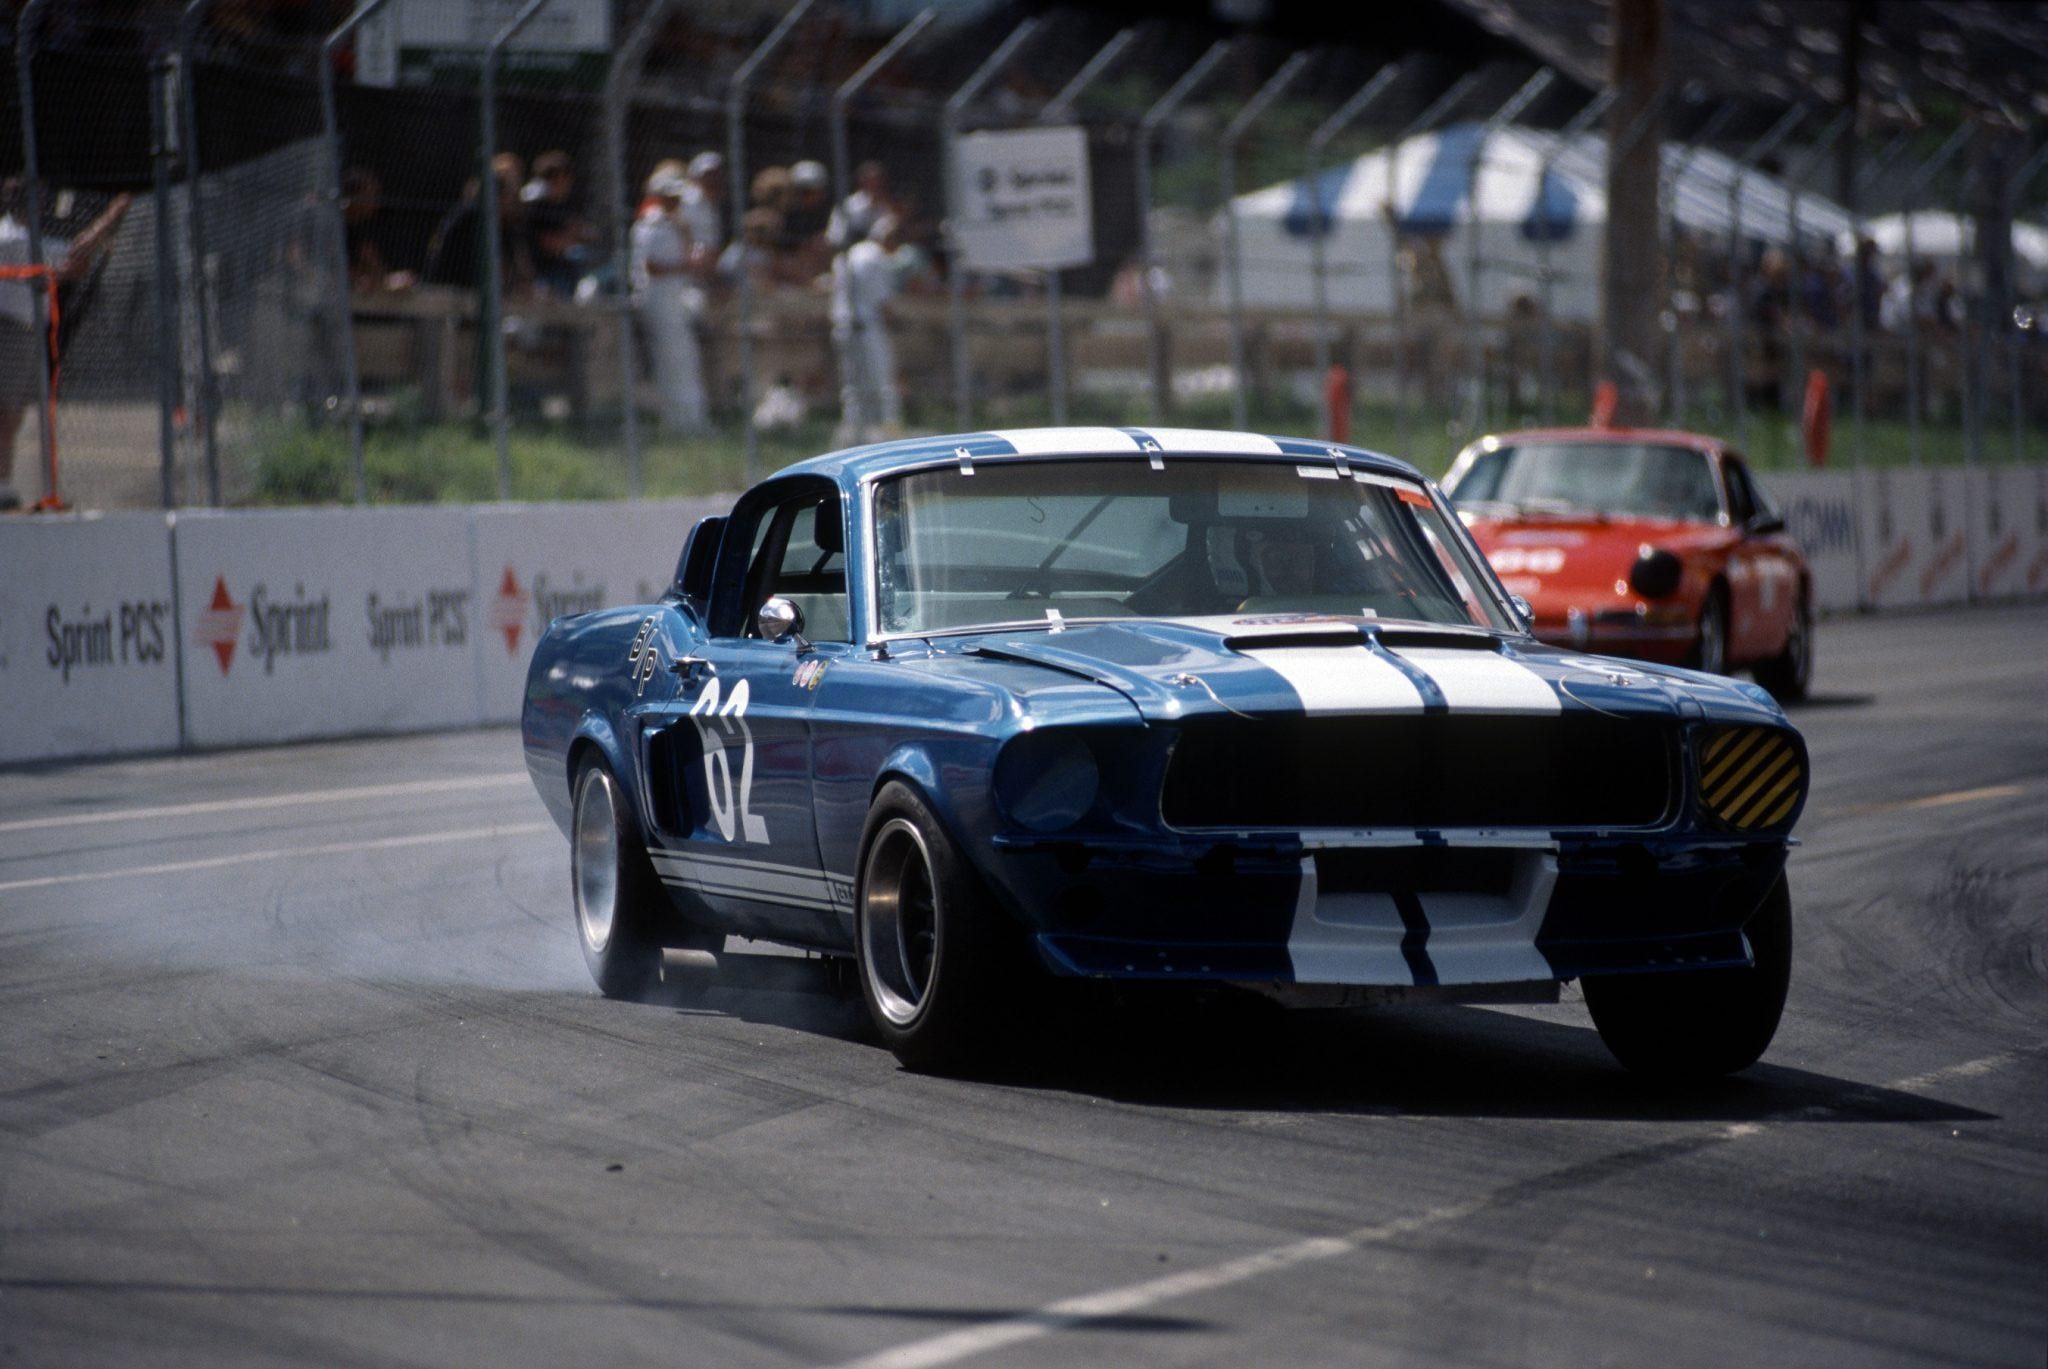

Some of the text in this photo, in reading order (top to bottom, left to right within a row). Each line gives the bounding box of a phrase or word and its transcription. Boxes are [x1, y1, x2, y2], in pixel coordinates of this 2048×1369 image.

[46, 600, 166, 684] Sprint PCS
[249, 581, 330, 677] Sprint
[367, 589, 424, 664] Sprint
[689, 676, 770, 845] 62
